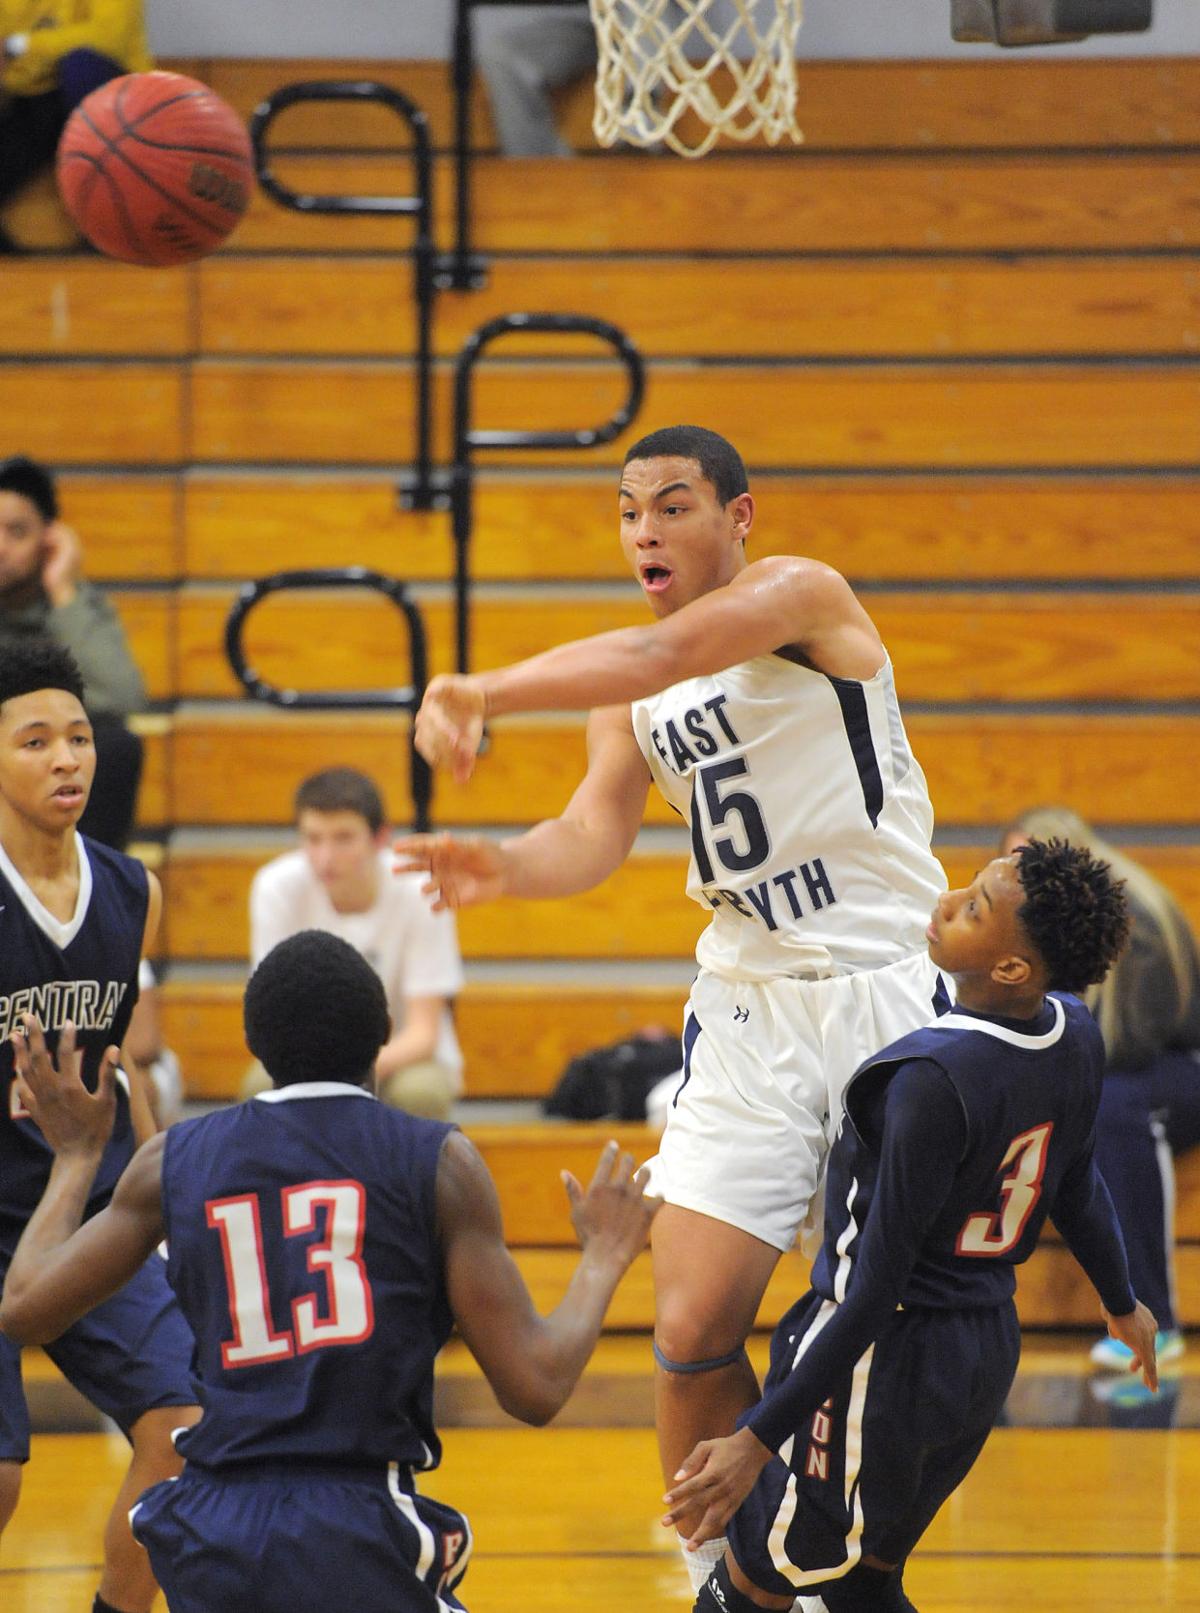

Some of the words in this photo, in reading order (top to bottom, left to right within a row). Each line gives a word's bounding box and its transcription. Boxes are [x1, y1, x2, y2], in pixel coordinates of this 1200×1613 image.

[690, 755, 772, 885] 15
[954, 1120, 1054, 1258] 3
[204, 1178, 375, 1370] 13
